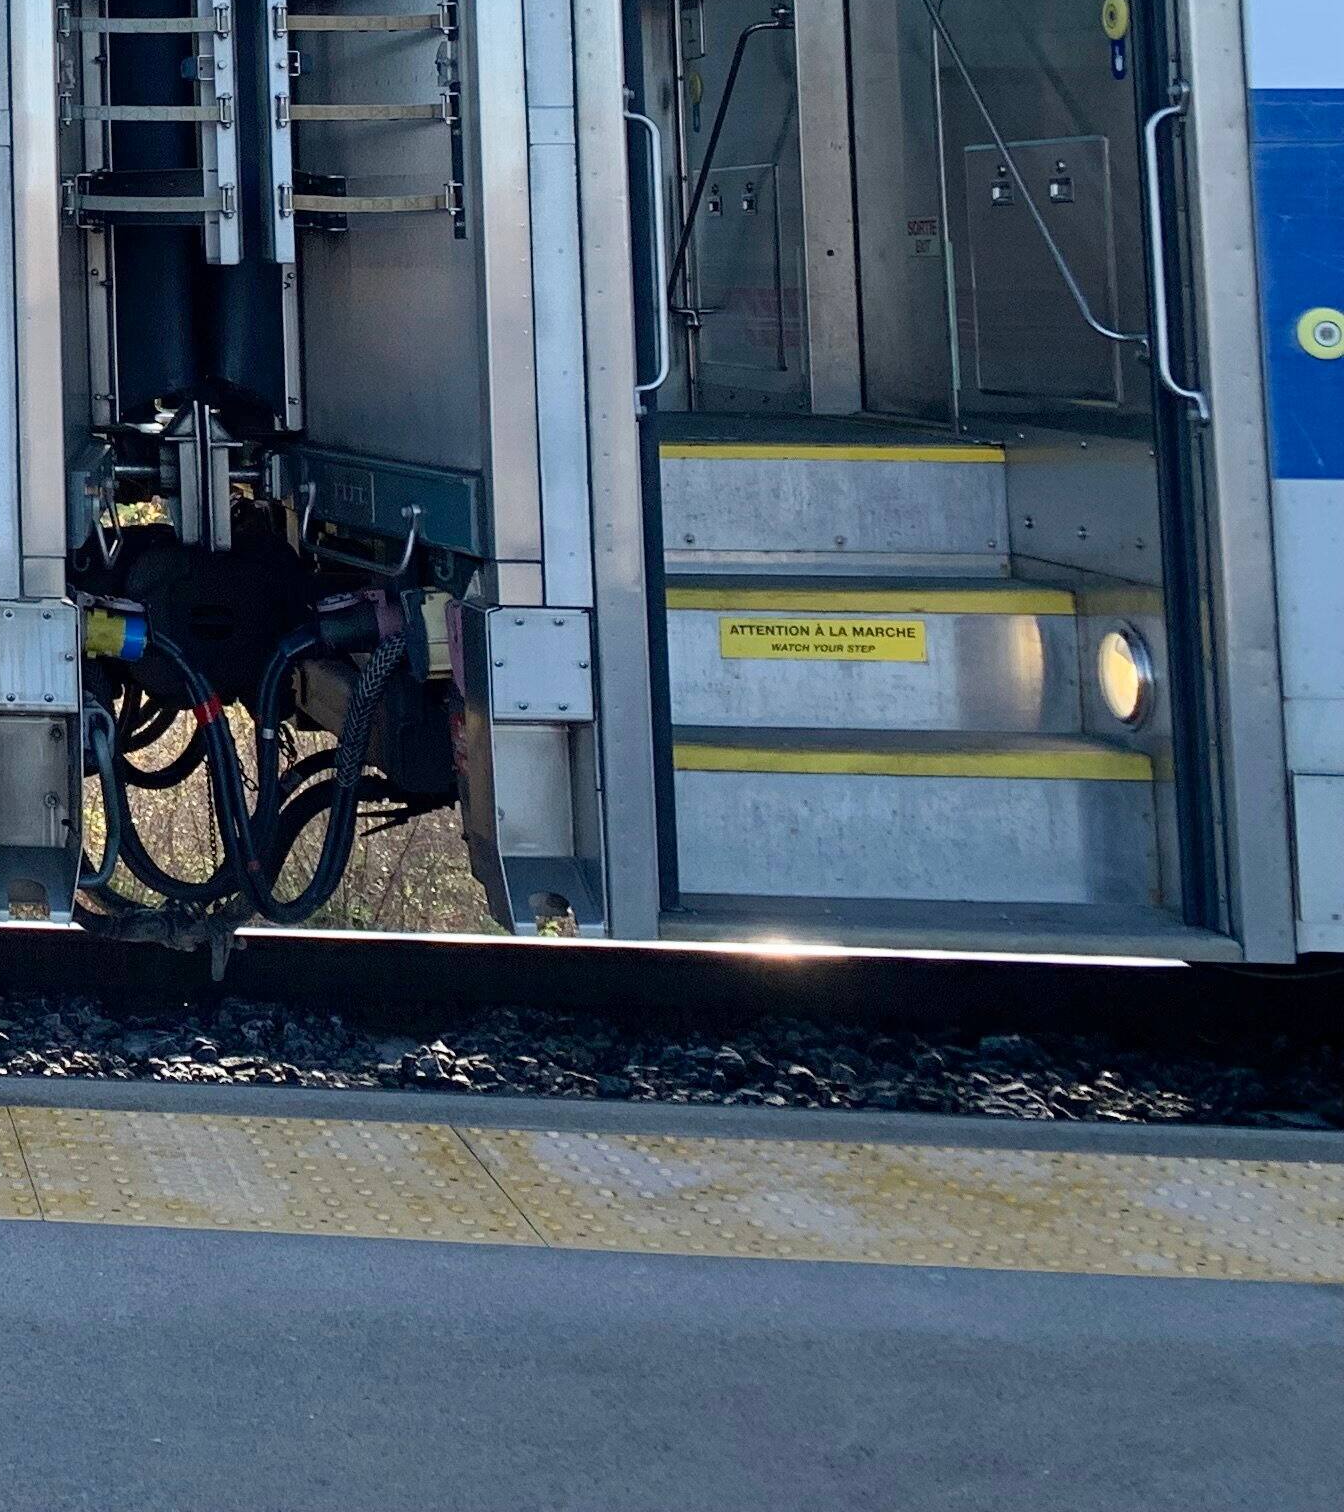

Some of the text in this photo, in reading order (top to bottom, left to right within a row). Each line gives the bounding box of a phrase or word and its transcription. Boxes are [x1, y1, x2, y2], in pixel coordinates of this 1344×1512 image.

[729, 623, 916, 638] ATTENTION À LA MARCHE
[771, 643, 876, 653] WATCH YOUR STEP
